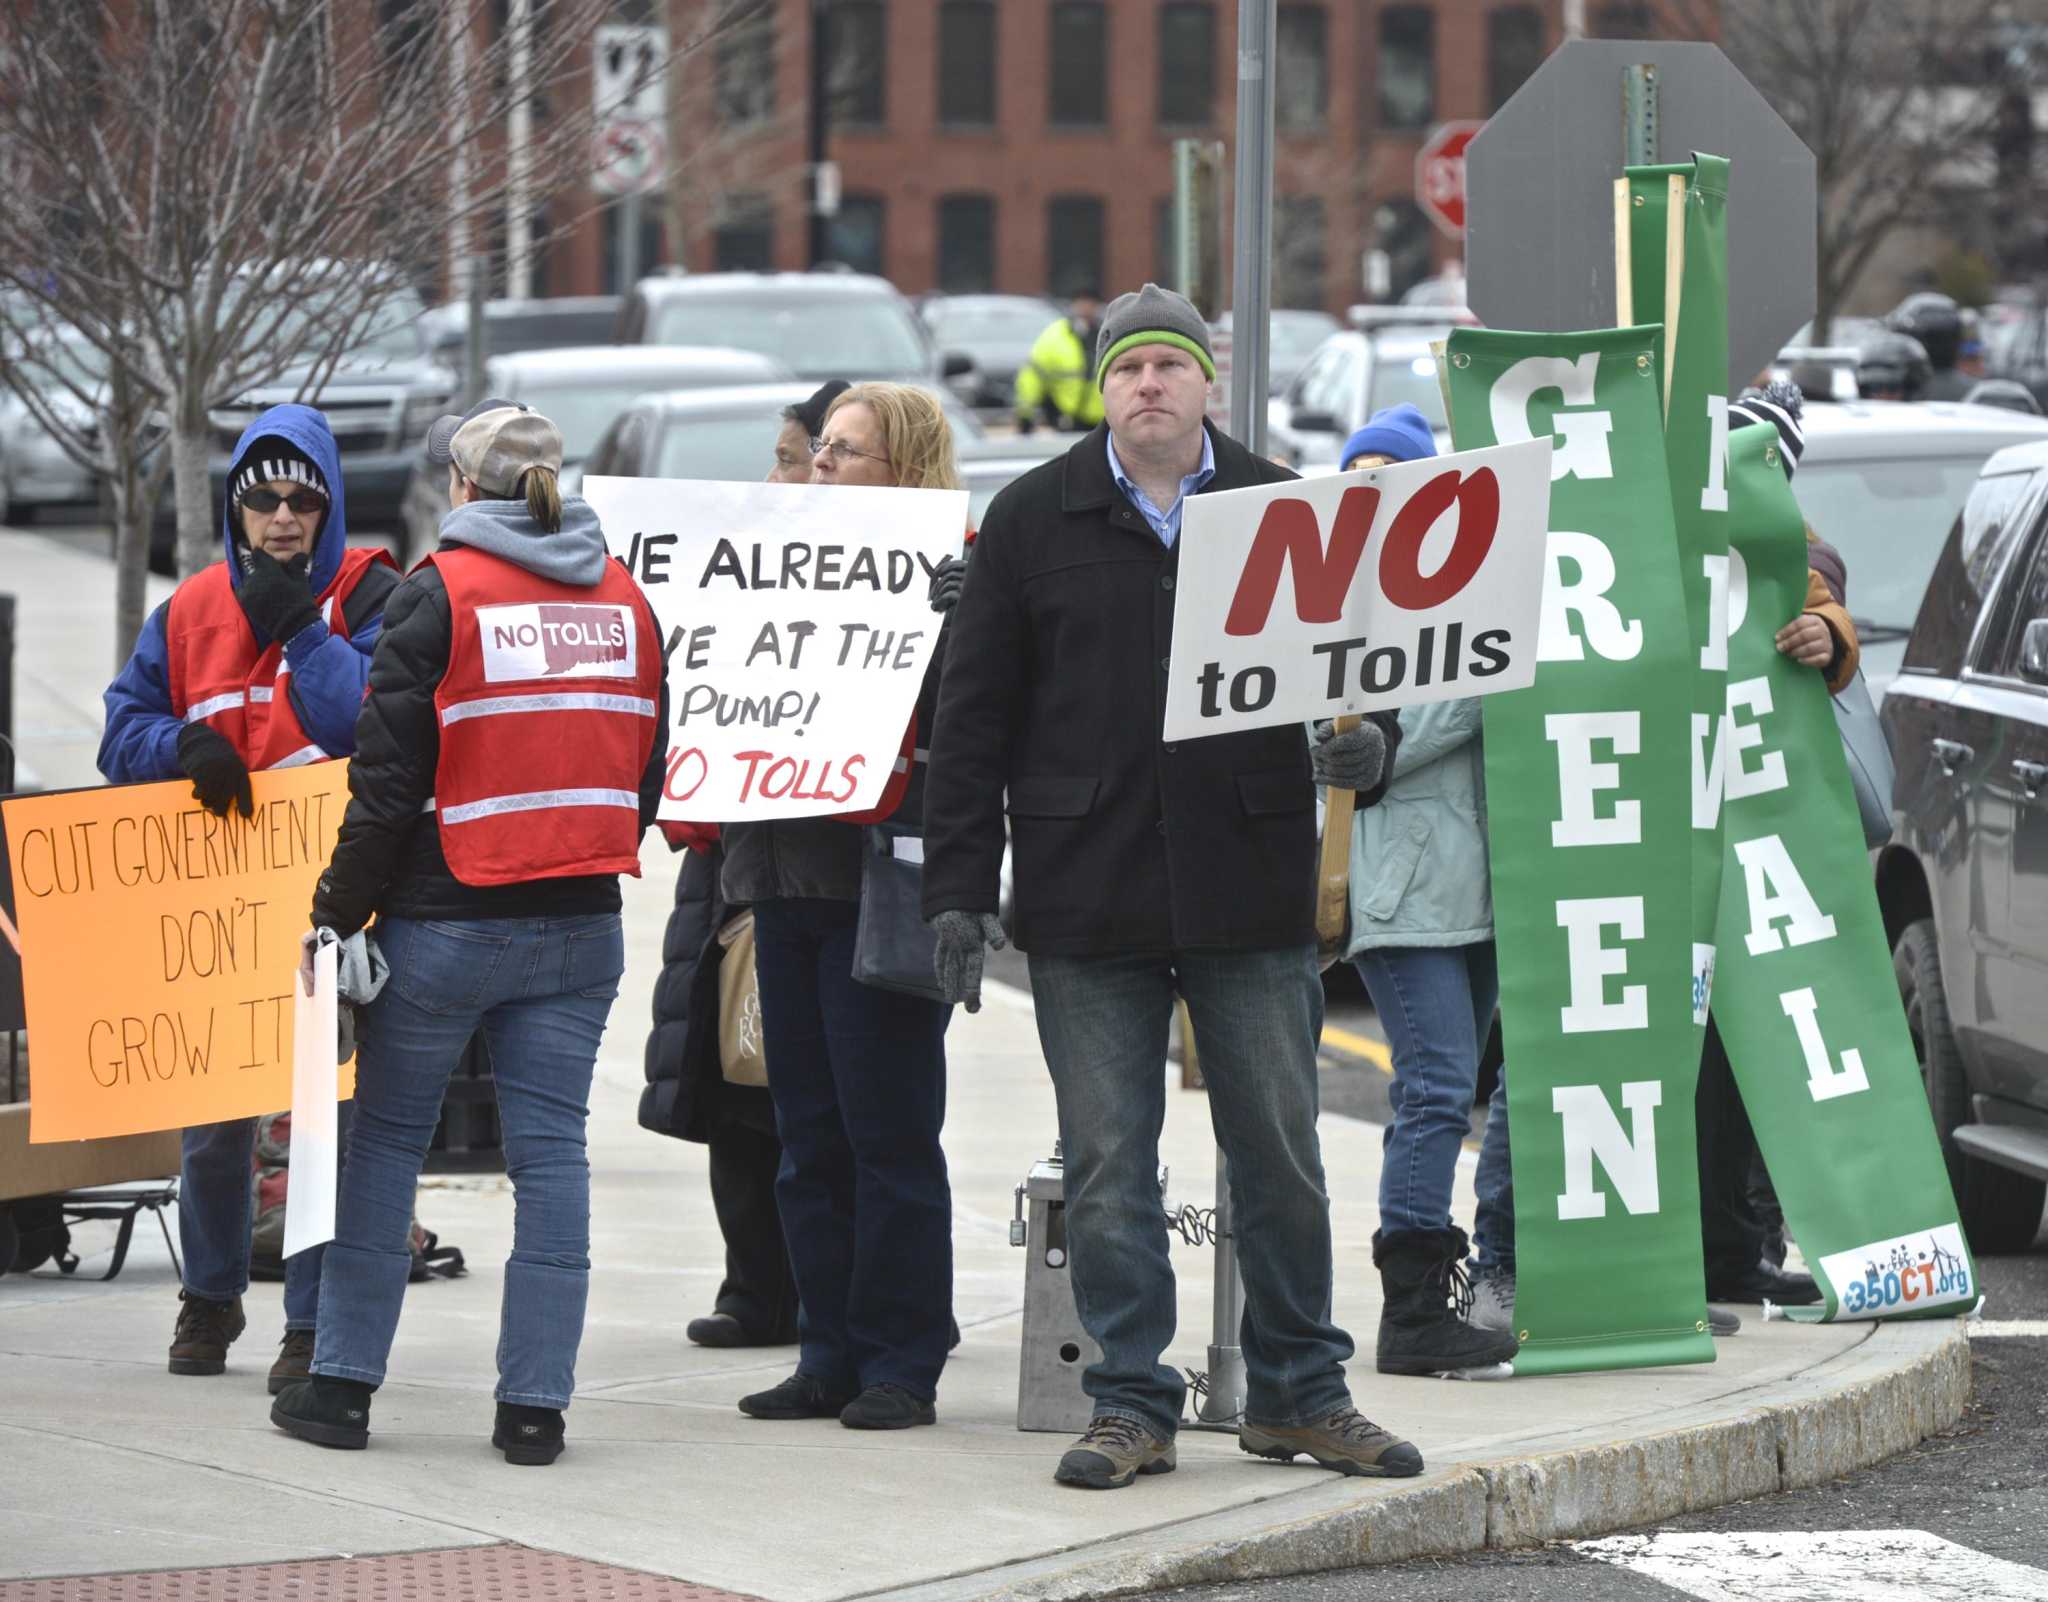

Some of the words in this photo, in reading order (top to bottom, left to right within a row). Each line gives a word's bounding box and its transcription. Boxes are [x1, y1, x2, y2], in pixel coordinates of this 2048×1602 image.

[699, 538, 953, 595] ALREADY
[1225, 466, 1500, 636] NO
[494, 624, 538, 649] NO
[543, 622, 625, 647] TOLLS
[745, 620, 817, 669] AT
[837, 623, 924, 670] THE
[1197, 662, 1276, 718] to
[1313, 622, 1511, 700] Tolls
[678, 684, 821, 736] PUMP!
[663, 746, 708, 801] O
[732, 750, 866, 804] TOLLS
[1490, 352, 1662, 1220] GREEN
[21, 821, 97, 897] CUT
[113, 792, 330, 887] GOVERNMENT
[1724, 544, 1870, 1102] EAL
[161, 897, 267, 982] DON'T
[88, 1007, 214, 1087] GROW
[239, 995, 293, 1069] IT
